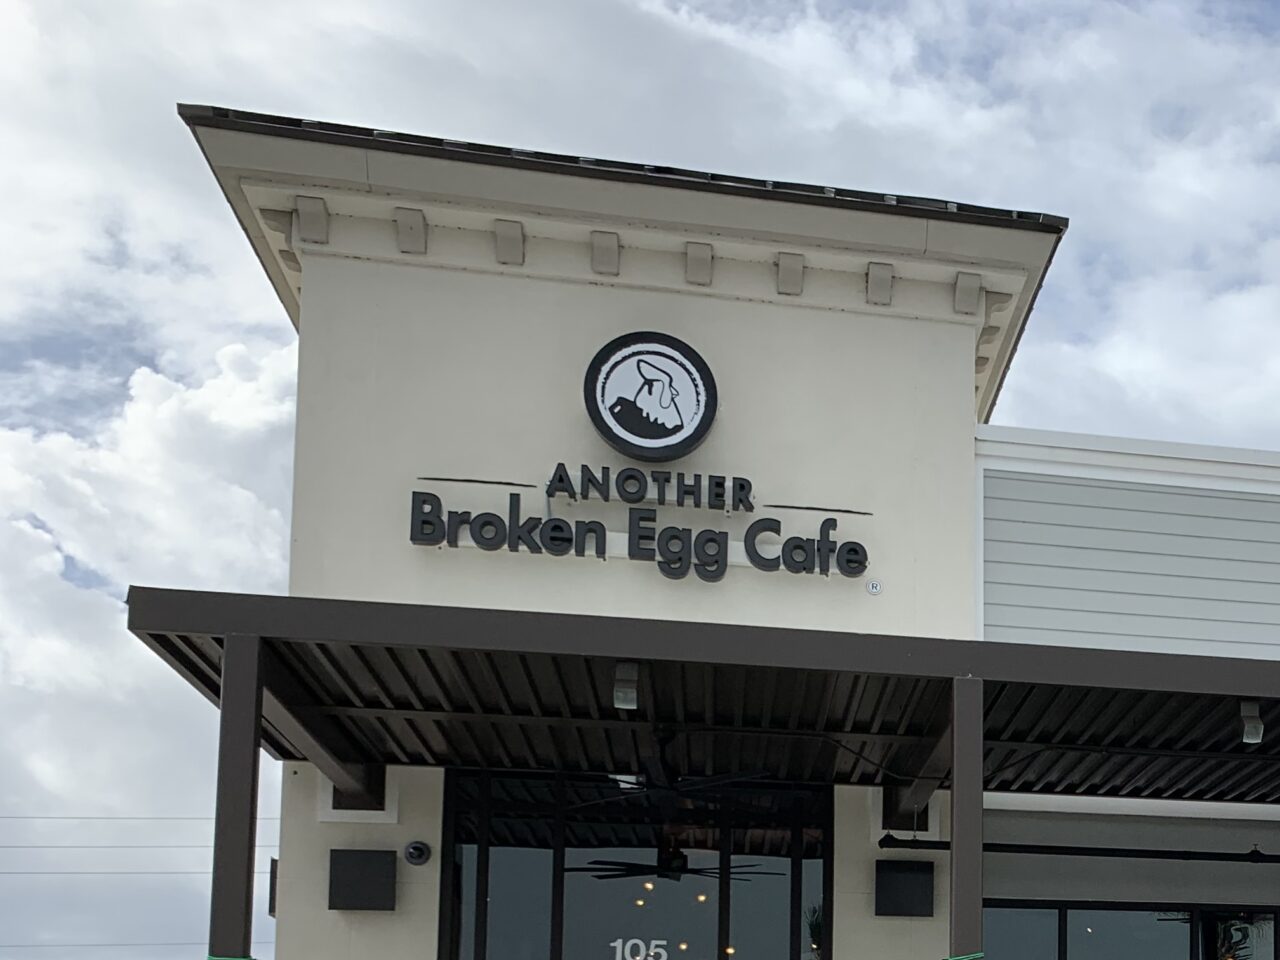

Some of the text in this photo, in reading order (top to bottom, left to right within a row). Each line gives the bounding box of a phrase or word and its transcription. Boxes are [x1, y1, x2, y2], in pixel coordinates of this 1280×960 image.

[546, 462, 755, 512] ANOTHER
[410, 490, 607, 560] Broken
[627, 507, 730, 583] Egg
[743, 517, 870, 578] Cafe
